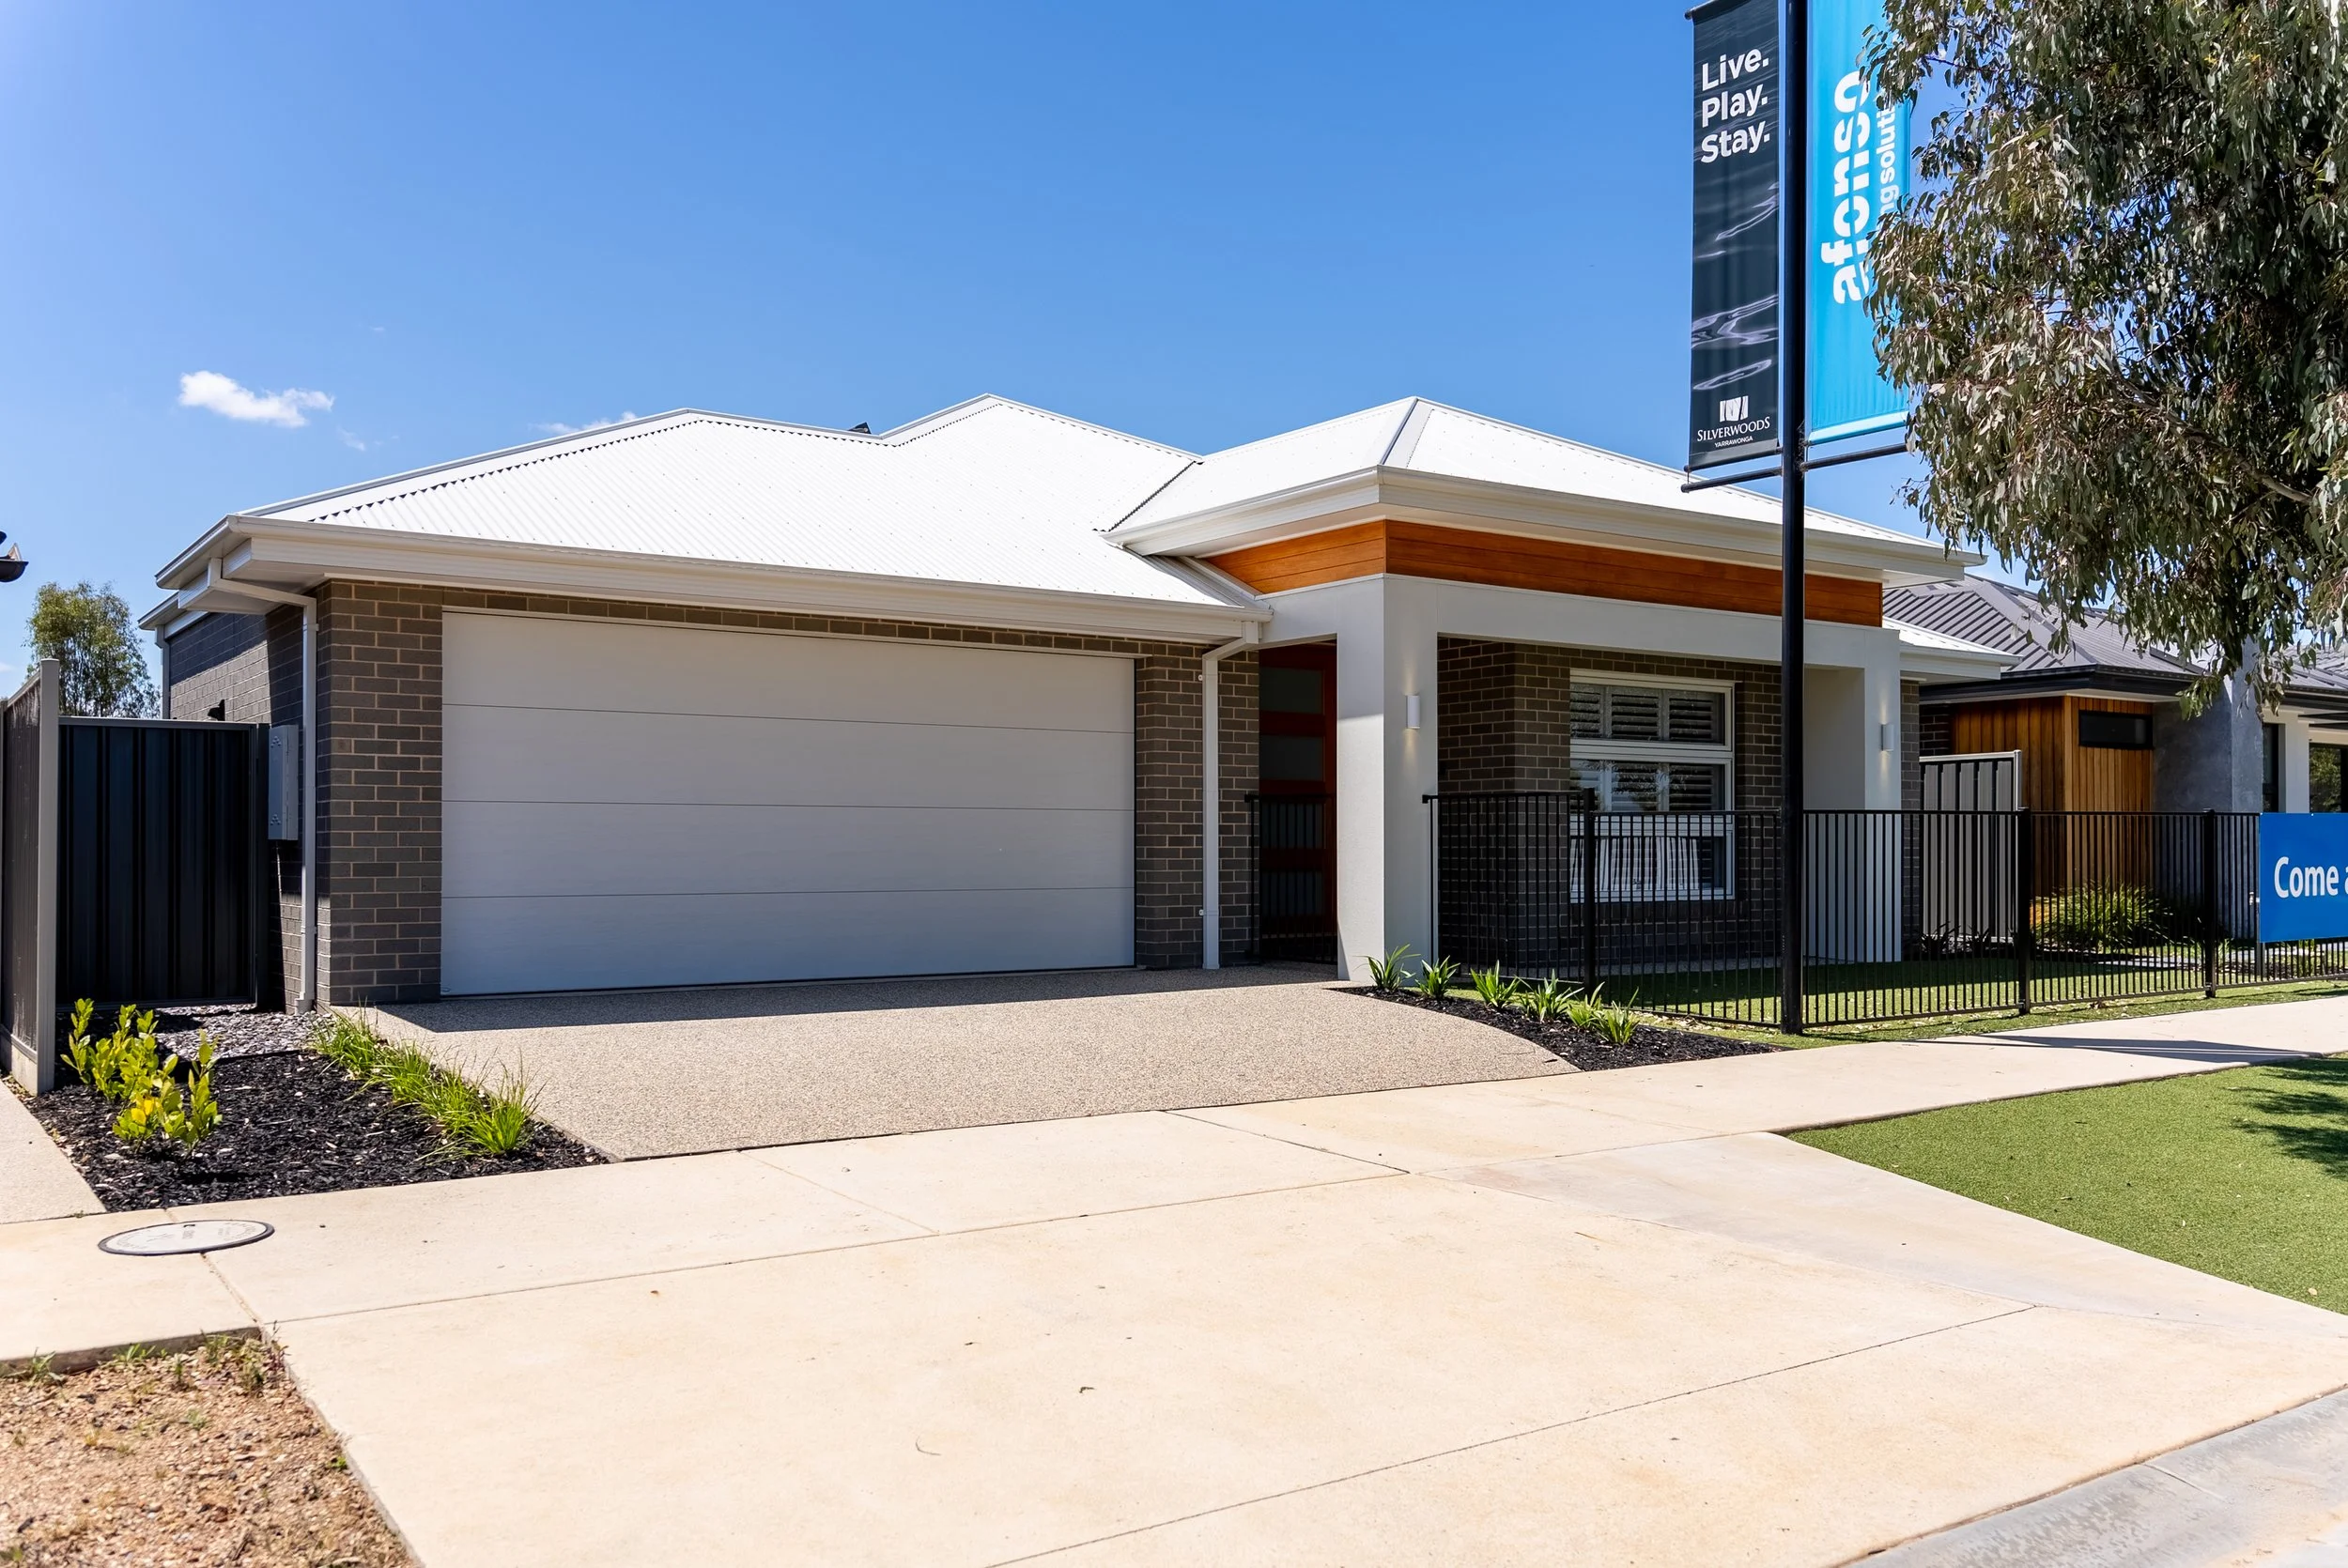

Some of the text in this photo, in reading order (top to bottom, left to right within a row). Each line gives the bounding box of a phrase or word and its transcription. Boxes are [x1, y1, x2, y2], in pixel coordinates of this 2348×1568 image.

[1702, 49, 1769, 91] Live.
[1702, 84, 1769, 128] Play.
[1700, 120, 1770, 163] Stay.
[1876, 106, 1895, 185] soluti
[1820, 70, 1871, 304] afonso
[1697, 417, 1770, 441] SILVERWOODS
[1714, 436, 1753, 448] YARRAWONGA
[2274, 856, 2340, 899] Come
